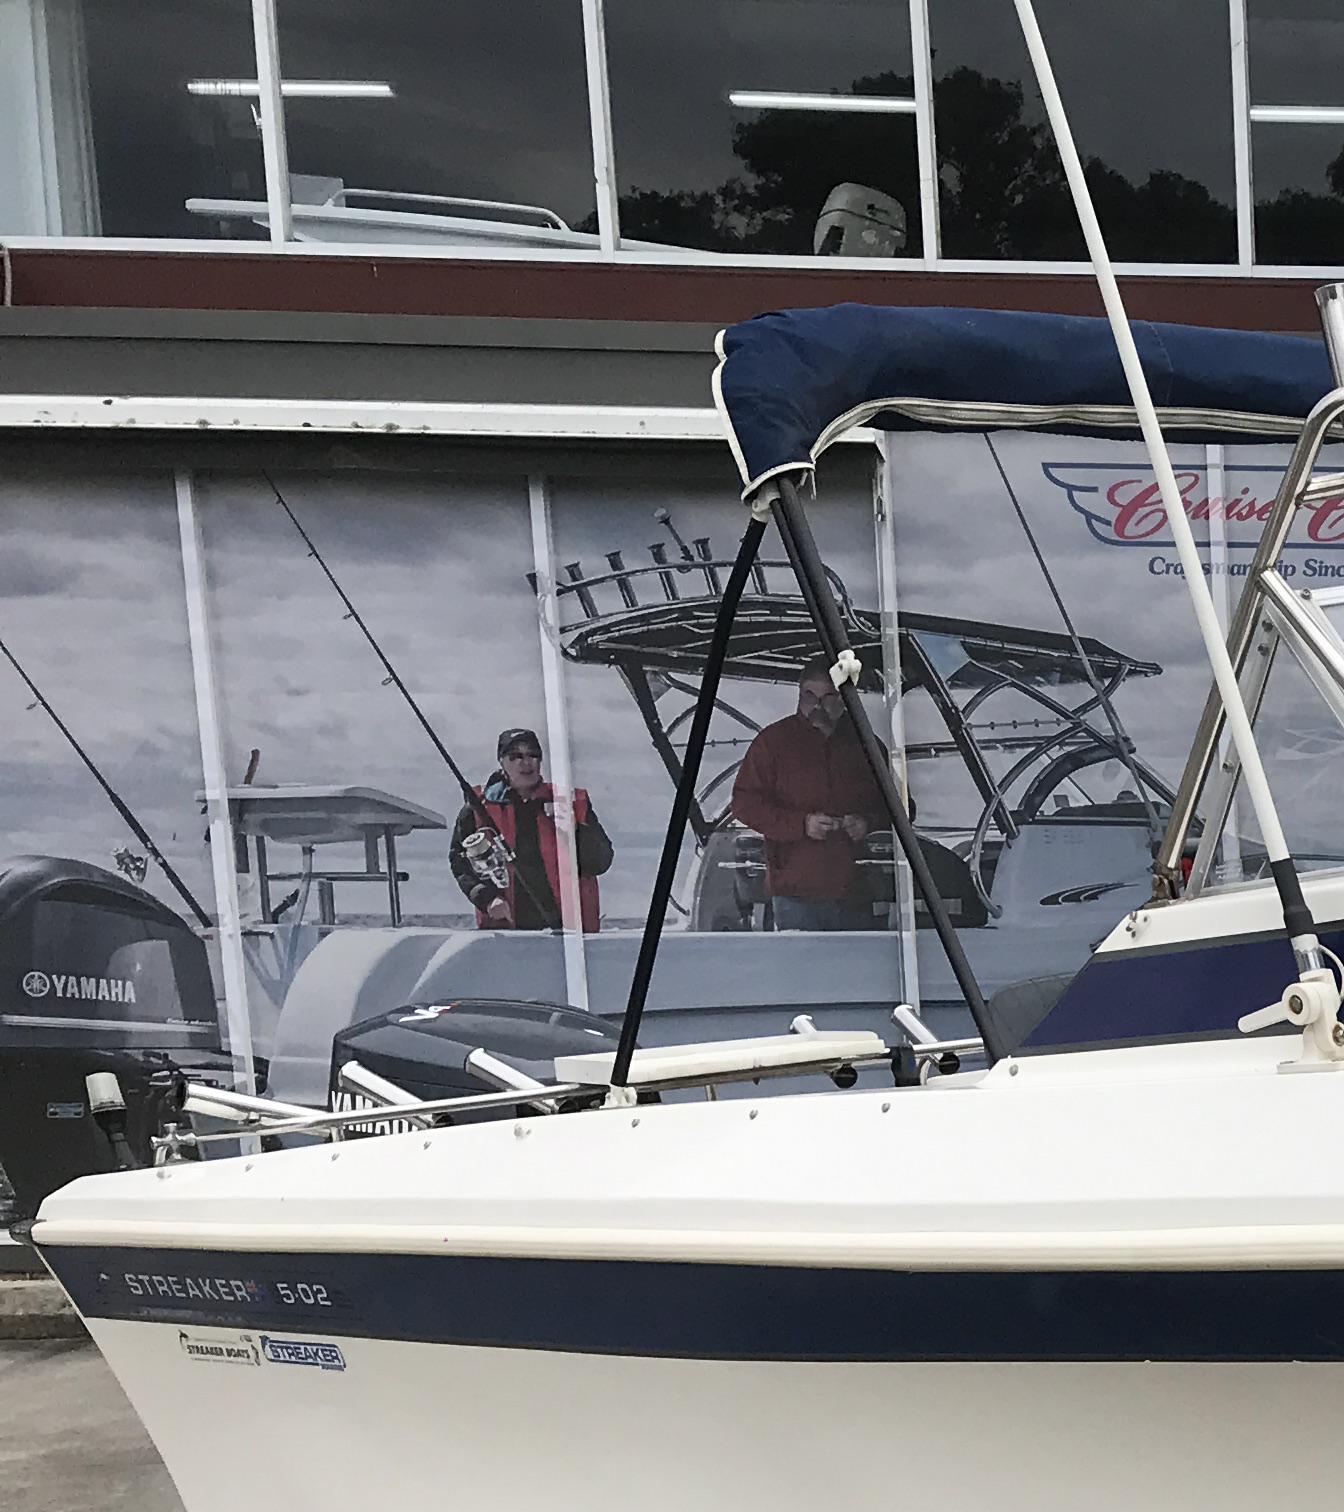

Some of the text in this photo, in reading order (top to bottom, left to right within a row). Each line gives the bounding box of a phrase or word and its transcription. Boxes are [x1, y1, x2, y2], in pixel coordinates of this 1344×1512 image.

[52, 974, 137, 1003] YAMAHA
[123, 1273, 250, 1302] STREAKER
[186, 1344, 224, 1357] STREAKER
[269, 1343, 341, 1365] STREAKER
